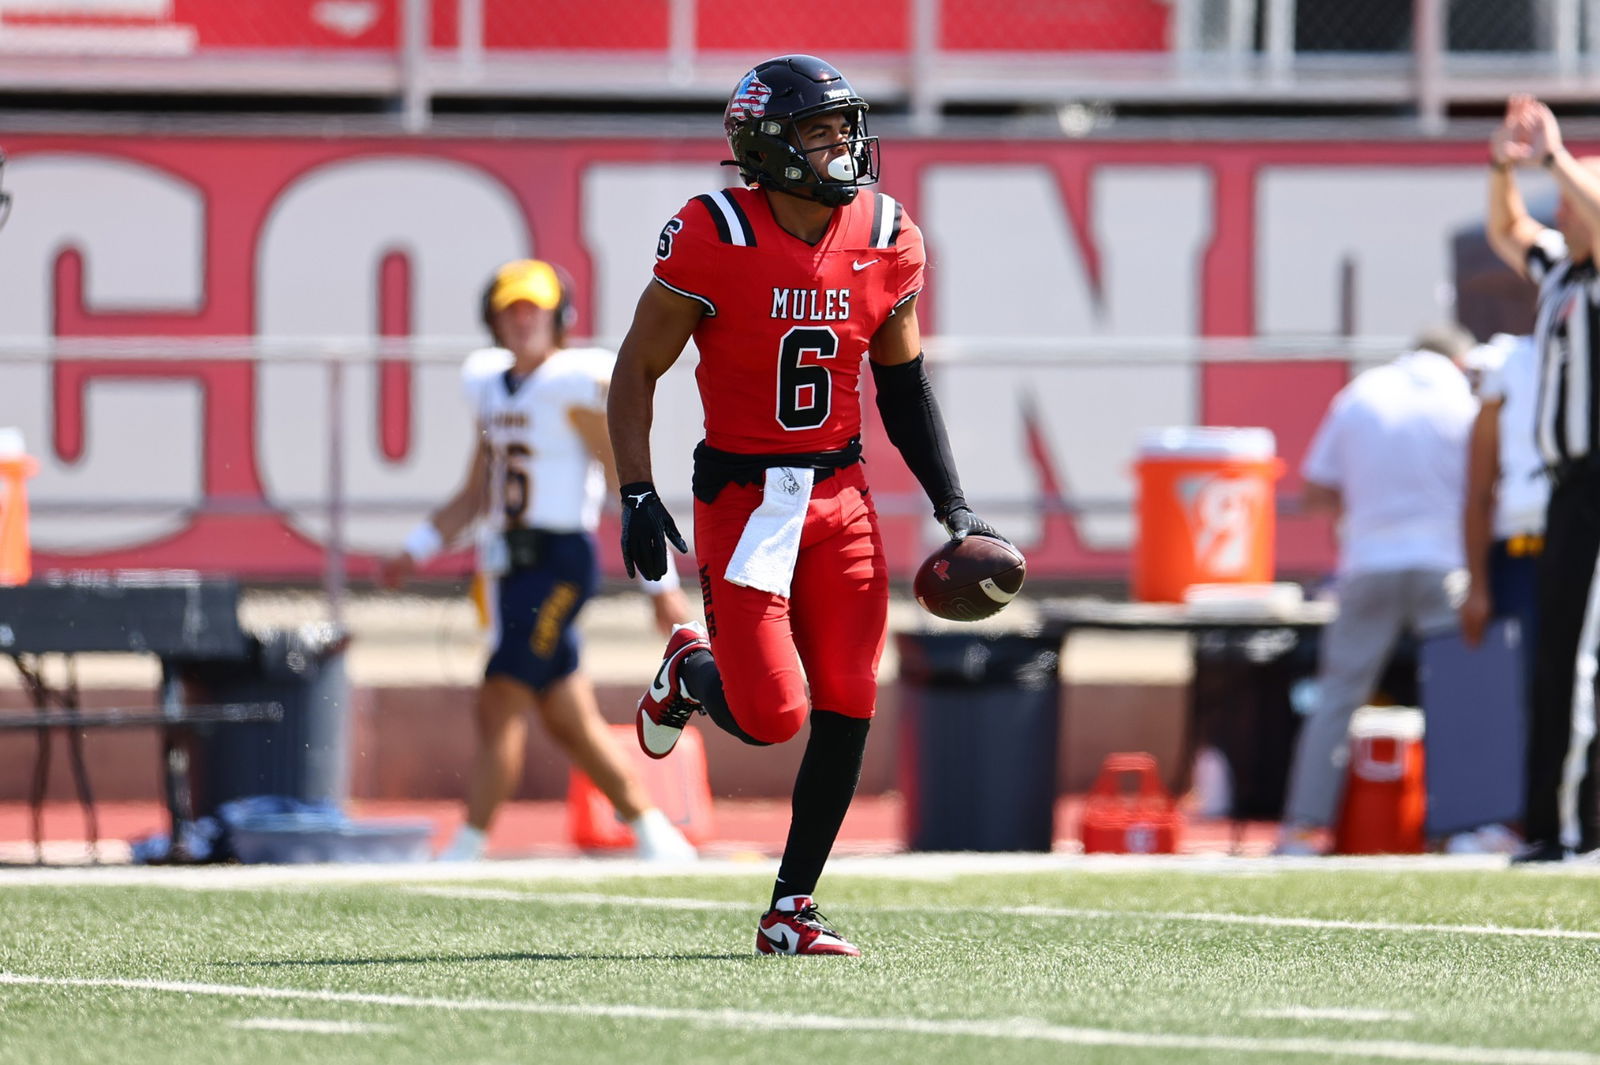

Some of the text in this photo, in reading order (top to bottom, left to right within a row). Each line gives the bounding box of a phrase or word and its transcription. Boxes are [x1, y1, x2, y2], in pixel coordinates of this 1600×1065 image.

[656, 217, 684, 261] 6
[770, 287, 850, 321] MULES
[775, 325, 839, 432] 6
